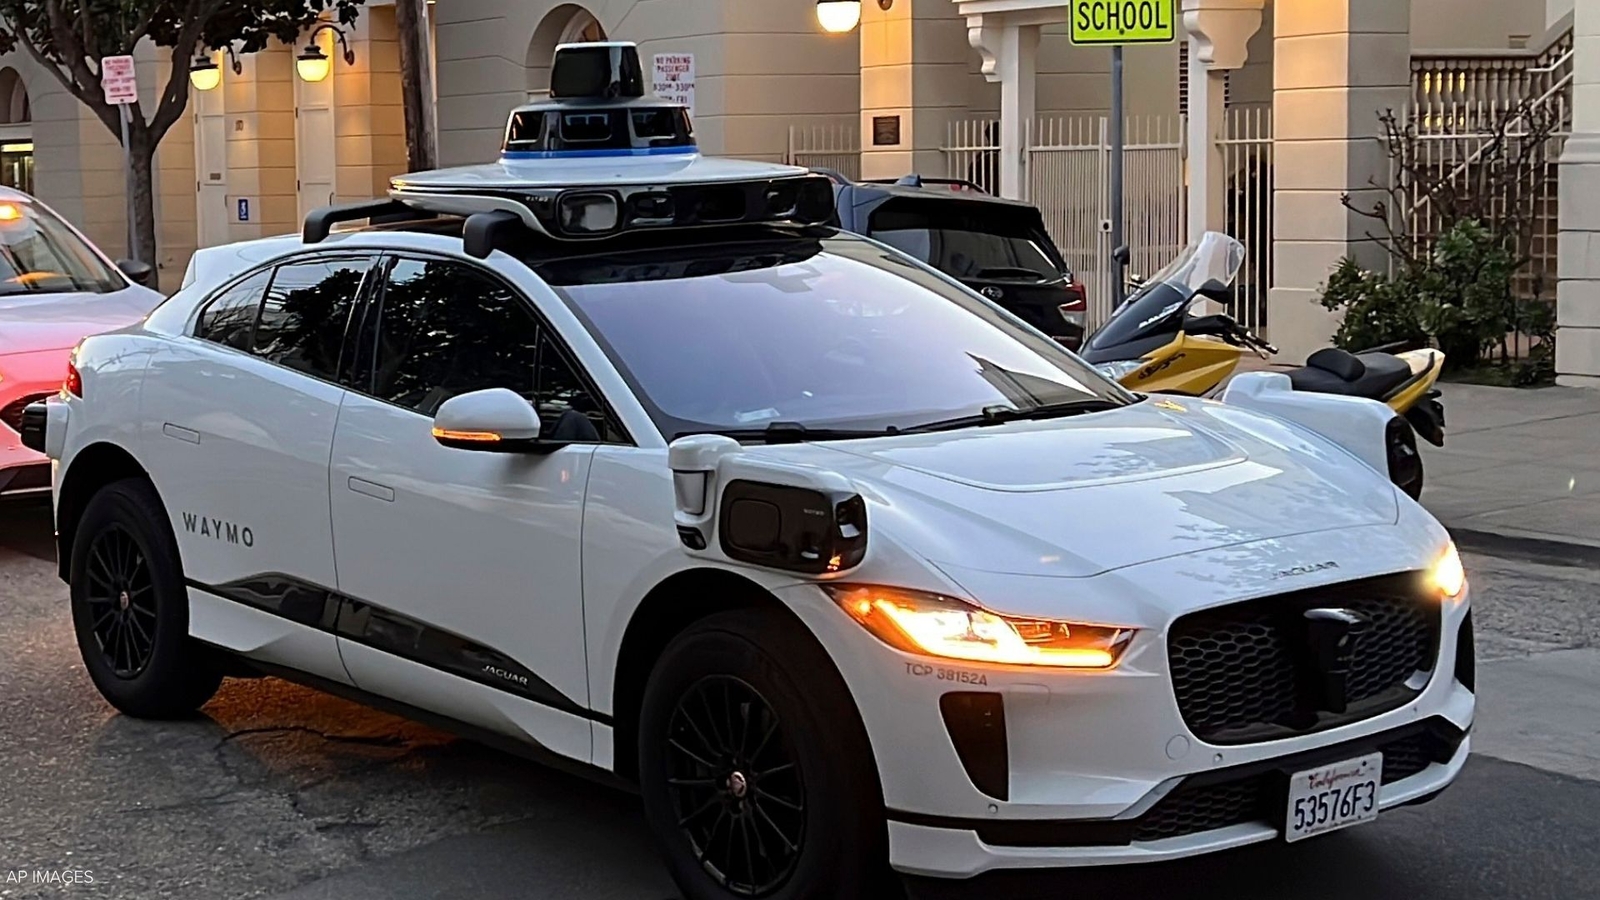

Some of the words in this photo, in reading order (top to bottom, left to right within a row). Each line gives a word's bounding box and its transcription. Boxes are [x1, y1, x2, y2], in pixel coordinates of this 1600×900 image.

[1077, 1, 1168, 31] SCHOOL
[657, 65, 689, 73] PASSENGER
[665, 56, 691, 65] PARKING
[182, 511, 254, 547] WAYMO
[1269, 561, 1340, 581] JAGUAR
[482, 665, 528, 686] JAGUAR
[904, 662, 933, 676] TCP
[937, 667, 988, 687] 38152A
[1294, 780, 1376, 831] 53576F3
